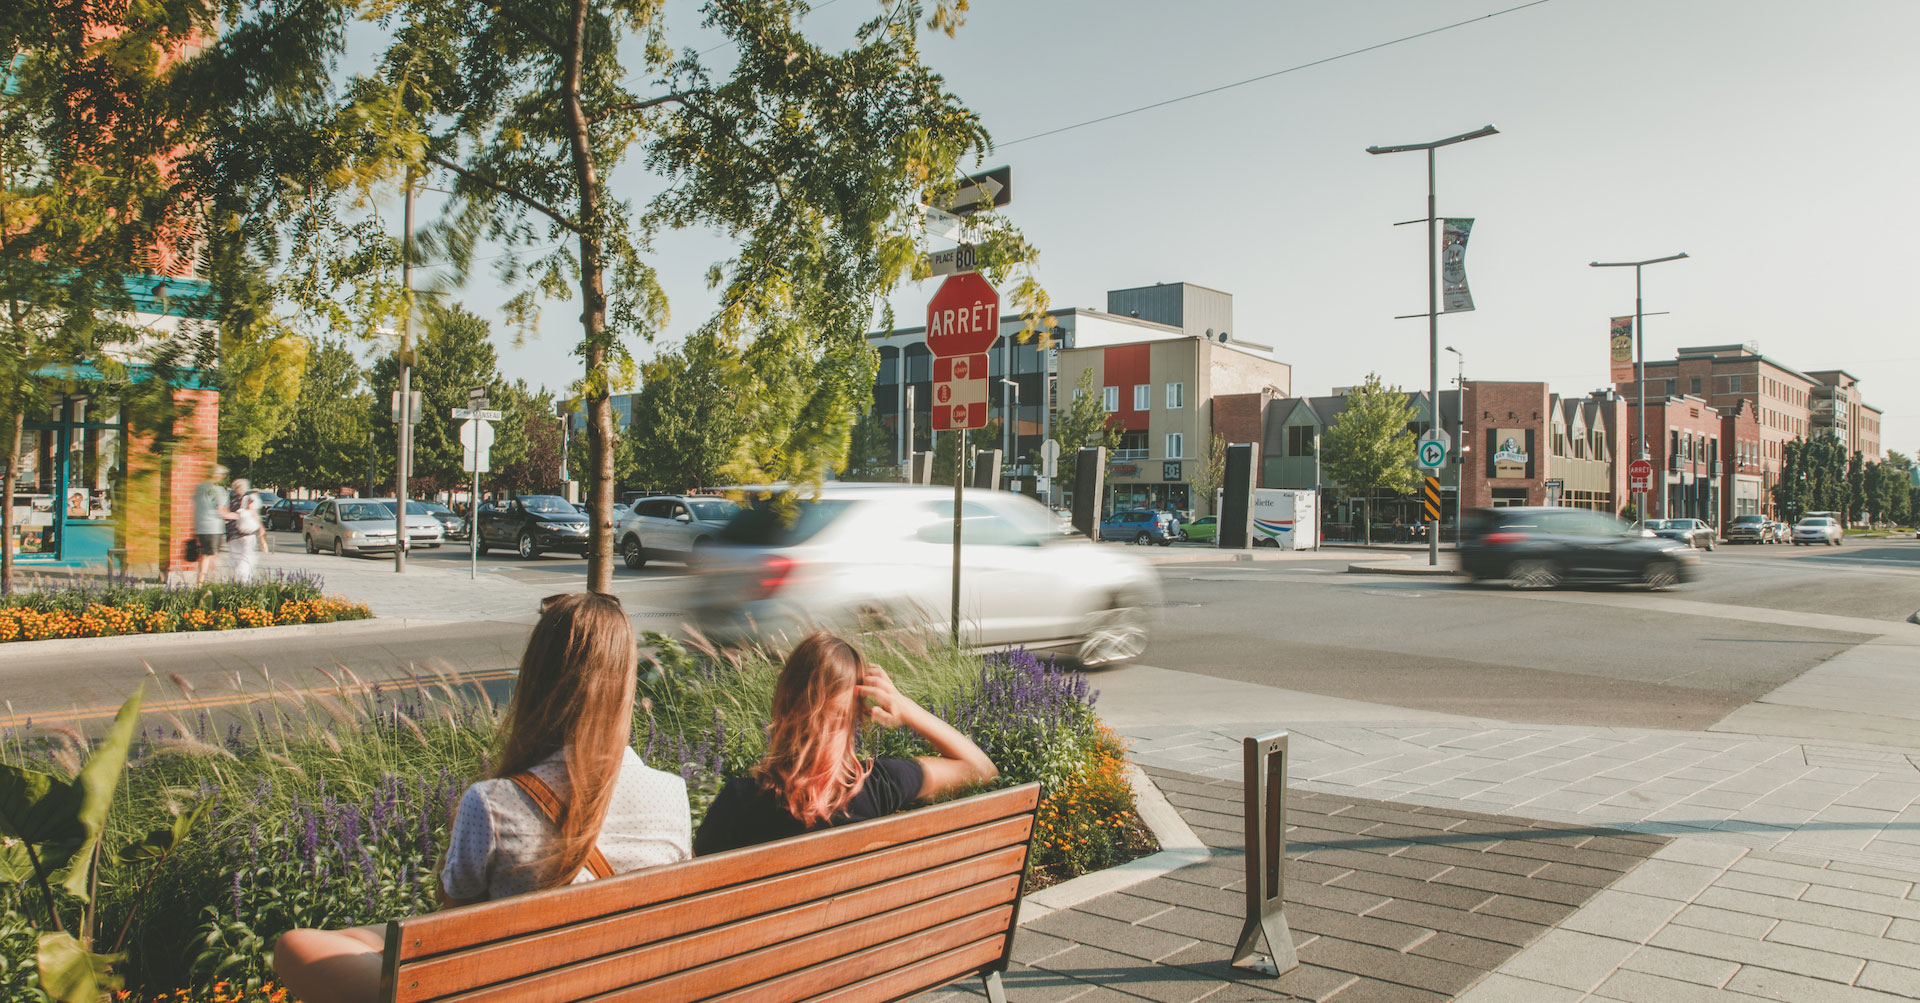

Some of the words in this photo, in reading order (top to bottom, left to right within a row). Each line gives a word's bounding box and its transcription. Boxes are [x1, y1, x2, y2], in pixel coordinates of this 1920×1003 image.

[935, 252, 954, 264] PLACE
[930, 300, 995, 337] ARRÊT
[1631, 465, 1650, 473] ARRÊT
[1255, 498, 1275, 507] oliette
